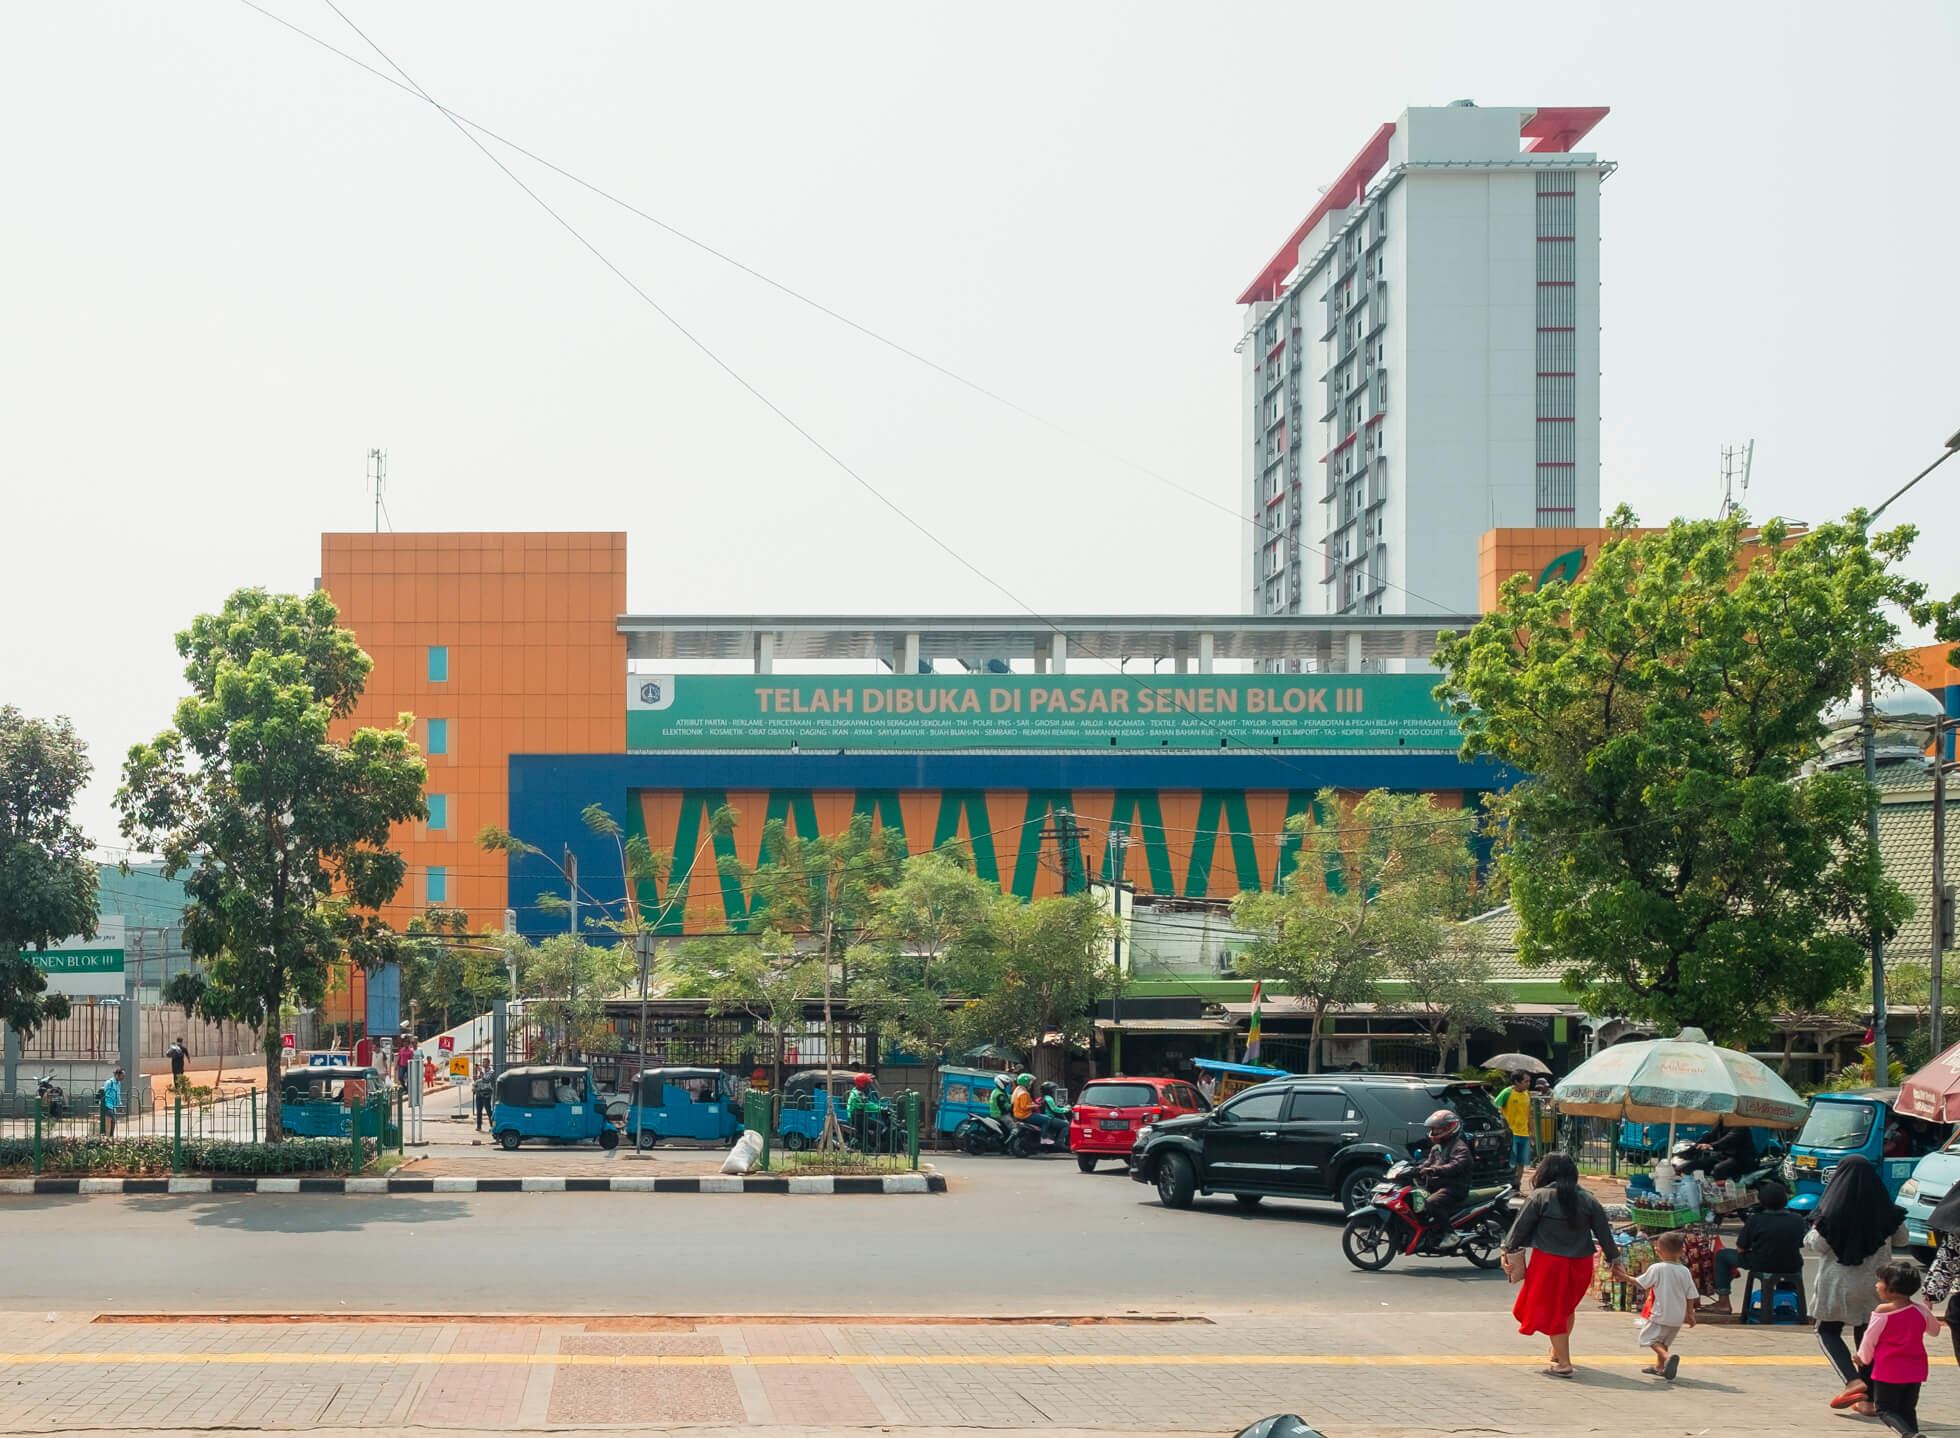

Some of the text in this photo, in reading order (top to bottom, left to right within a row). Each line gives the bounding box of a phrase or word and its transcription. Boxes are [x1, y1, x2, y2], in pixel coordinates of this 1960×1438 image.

[755, 688, 1363, 713] TELAH DIBUKA DI PASAR SENEN BLOK III
[676, 719, 703, 727] ATRIBUT
[704, 719, 728, 727] PARTAI
[732, 719, 764, 727] REKLAME
[768, 719, 812, 727] PERCETAKAN
[816, 719, 869, 727] PERLENGKAPAN
[870, 719, 885, 727] DAN
[886, 719, 919, 727] SERAGAM
[920, 719, 952, 727] SEKOLAH
[956, 719, 968, 727] TNI
[973, 719, 993, 727] POLRI
[997, 719, 1012, 727] PNS
[1060, 719, 1075, 727] JAM
[1108, 719, 1145, 727] KACAMATA
[1151, 719, 1176, 727] TEXTILE
[1182, 719, 1198, 727] ALAT
[1217, 719, 1237, 727] JAHIT
[1242, 719, 1267, 727] TAYLOR
[1271, 719, 1298, 727] BORDIR
[1304, 719, 1345, 727] PERABOTAN
[1352, 719, 1375, 727] PECAH
[1375, 719, 1398, 727] BELAH
[1403, 719, 1441, 727] PERHIASAN
[1442, 719, 1460, 727] EMA
[662, 728, 703, 736] ELEKTRONIK
[709, 728, 743, 736] KOSMETIK
[748, 728, 766, 736] OBAT
[768, 728, 795, 736] OBATAN
[800, 728, 827, 736] DAGING
[832, 728, 849, 736] IKAN
[854, 728, 873, 736] AYAM
[878, 728, 900, 736] SAYUR
[900, 728, 925, 736] MAYUR
[930, 728, 949, 736] BUAH
[950, 728, 980, 736] BUAHAN
[984, 728, 1018, 736] SEMBAKO
[1022, 728, 1051, 736] REMPAH
[1051, 728, 1080, 736] REMPAH
[1085, 728, 1121, 736] MAKANAN
[1121, 728, 1145, 736] KEMAS
[1149, 728, 1175, 736] BAHAN
[1175, 728, 1200, 736] BAHAN
[1201, 728, 1214, 736] KUE
[1252, 728, 1281, 736] PAKAIAN
[1324, 728, 1337, 736] TAS
[1341, 728, 1364, 736] KOPER
[1369, 728, 1394, 736] SEPATU
[1399, 728, 1419, 736] FOOD
[1420, 728, 1444, 736] COURT
[30, 955, 113, 968] ENEN BLOK III
